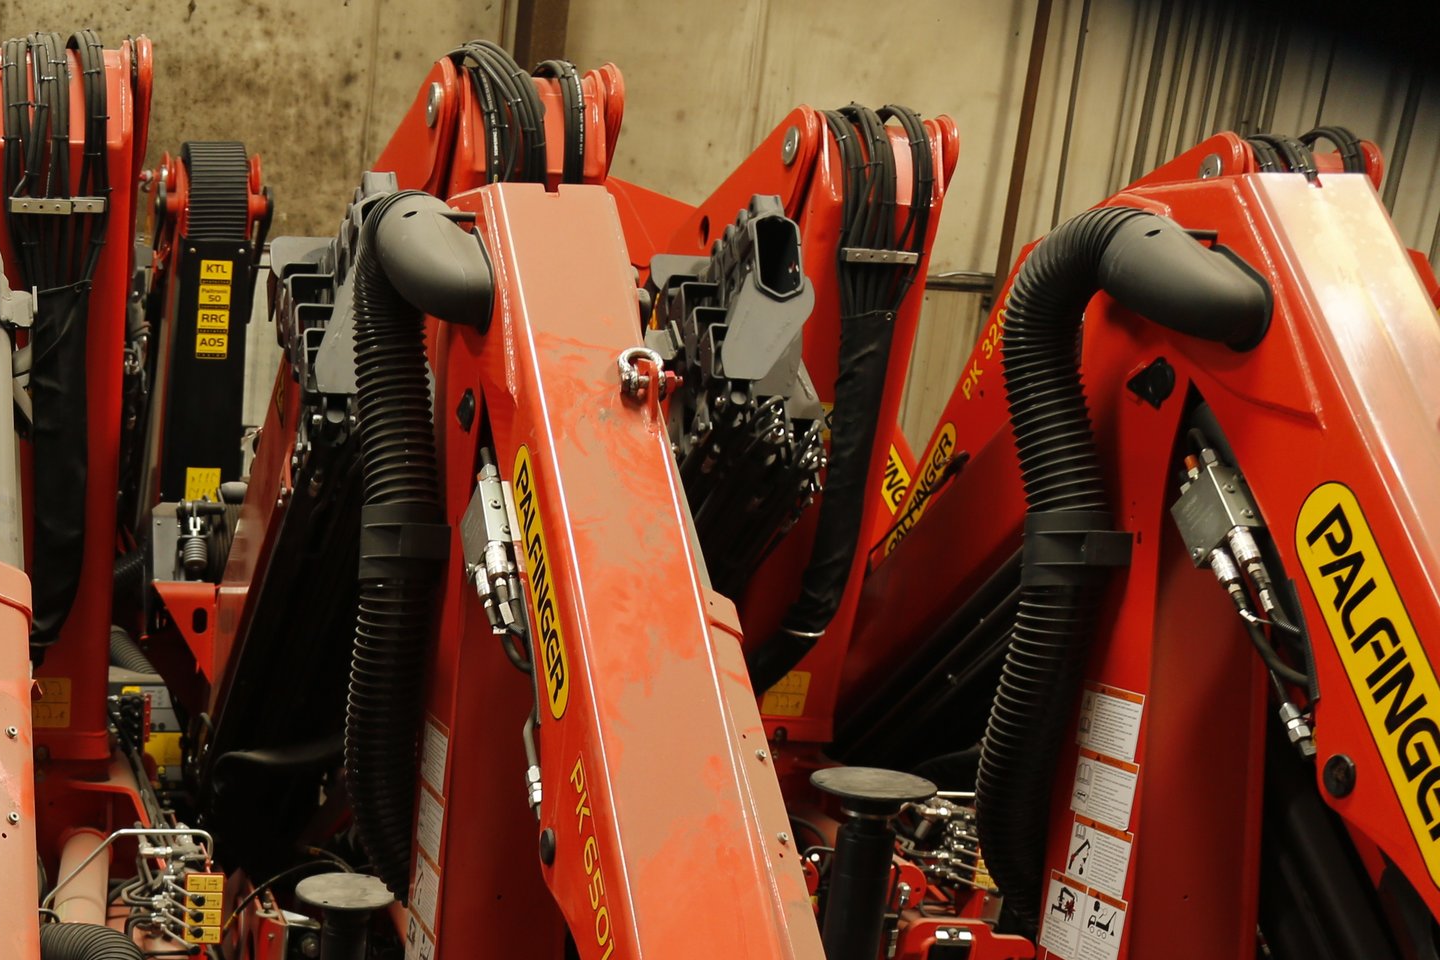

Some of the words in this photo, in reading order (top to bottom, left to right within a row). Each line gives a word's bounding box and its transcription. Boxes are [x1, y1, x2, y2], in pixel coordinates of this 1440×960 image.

[206, 264, 227, 273] KTL
[201, 313, 226, 324] RRC
[199, 337, 225, 347] AOS
[962, 360, 983, 400] PK
[515, 458, 565, 704] PALFINGER
[570, 758, 591, 834] PK
